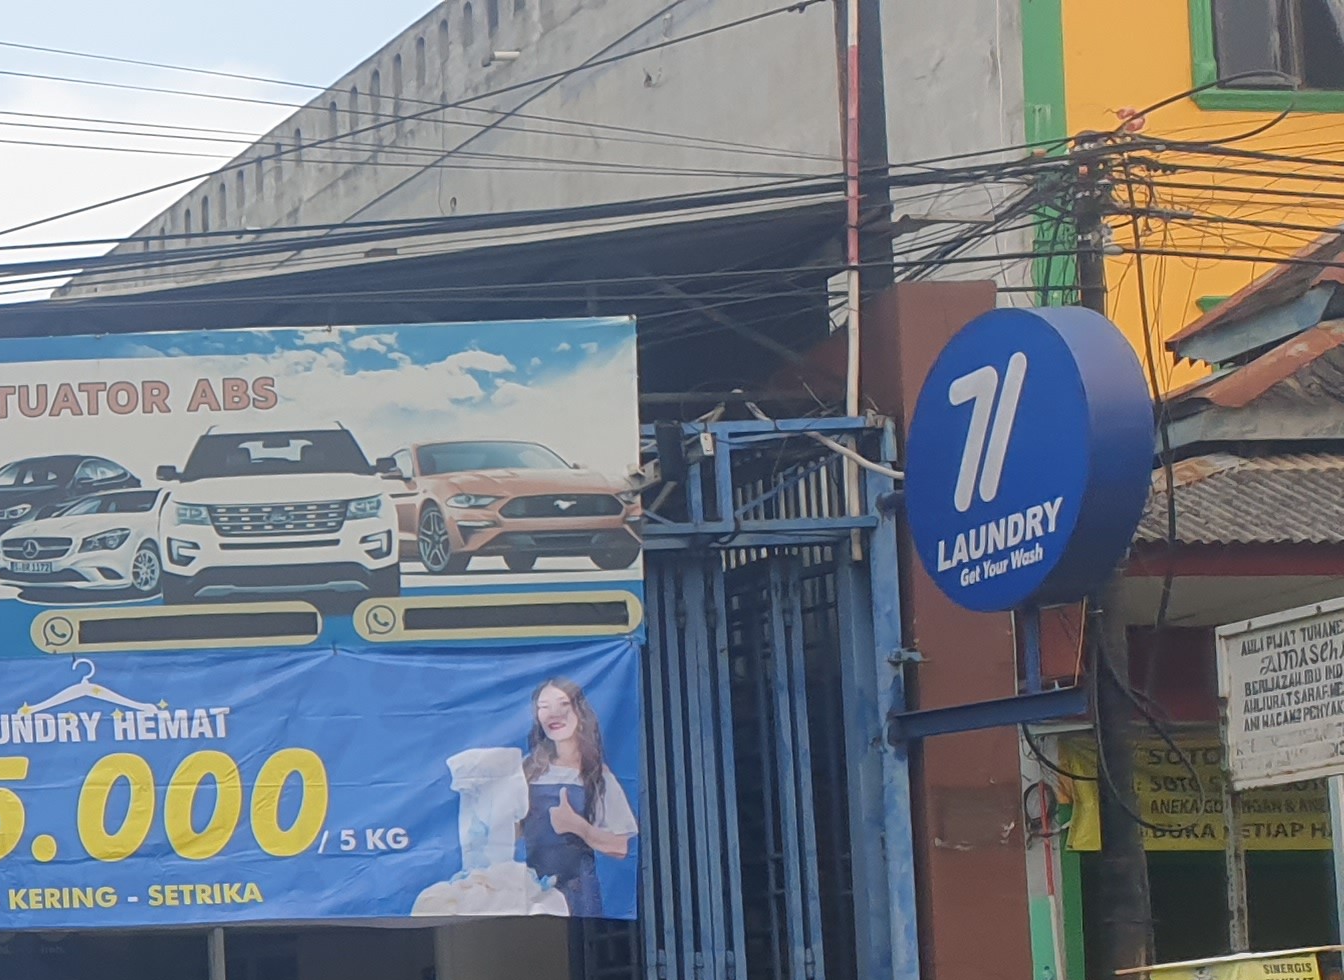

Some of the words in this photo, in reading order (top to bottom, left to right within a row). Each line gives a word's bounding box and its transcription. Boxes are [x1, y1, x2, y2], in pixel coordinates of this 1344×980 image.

[186, 375, 279, 412] ABS
[937, 495, 1064, 574] LAUNDRY
[960, 564, 981, 587] Get
[983, 557, 1009, 580] Your
[1010, 542, 1044, 570] Wash
[1266, 629, 1296, 650] PIJAT
[112, 706, 232, 742] HEMAT
[340, 829, 356, 851] 5
[365, 827, 409, 850] KG
[8, 885, 118, 911] KERING
[148, 881, 264, 909] SETRIKA
[1263, 962, 1312, 975] SINERGIS
